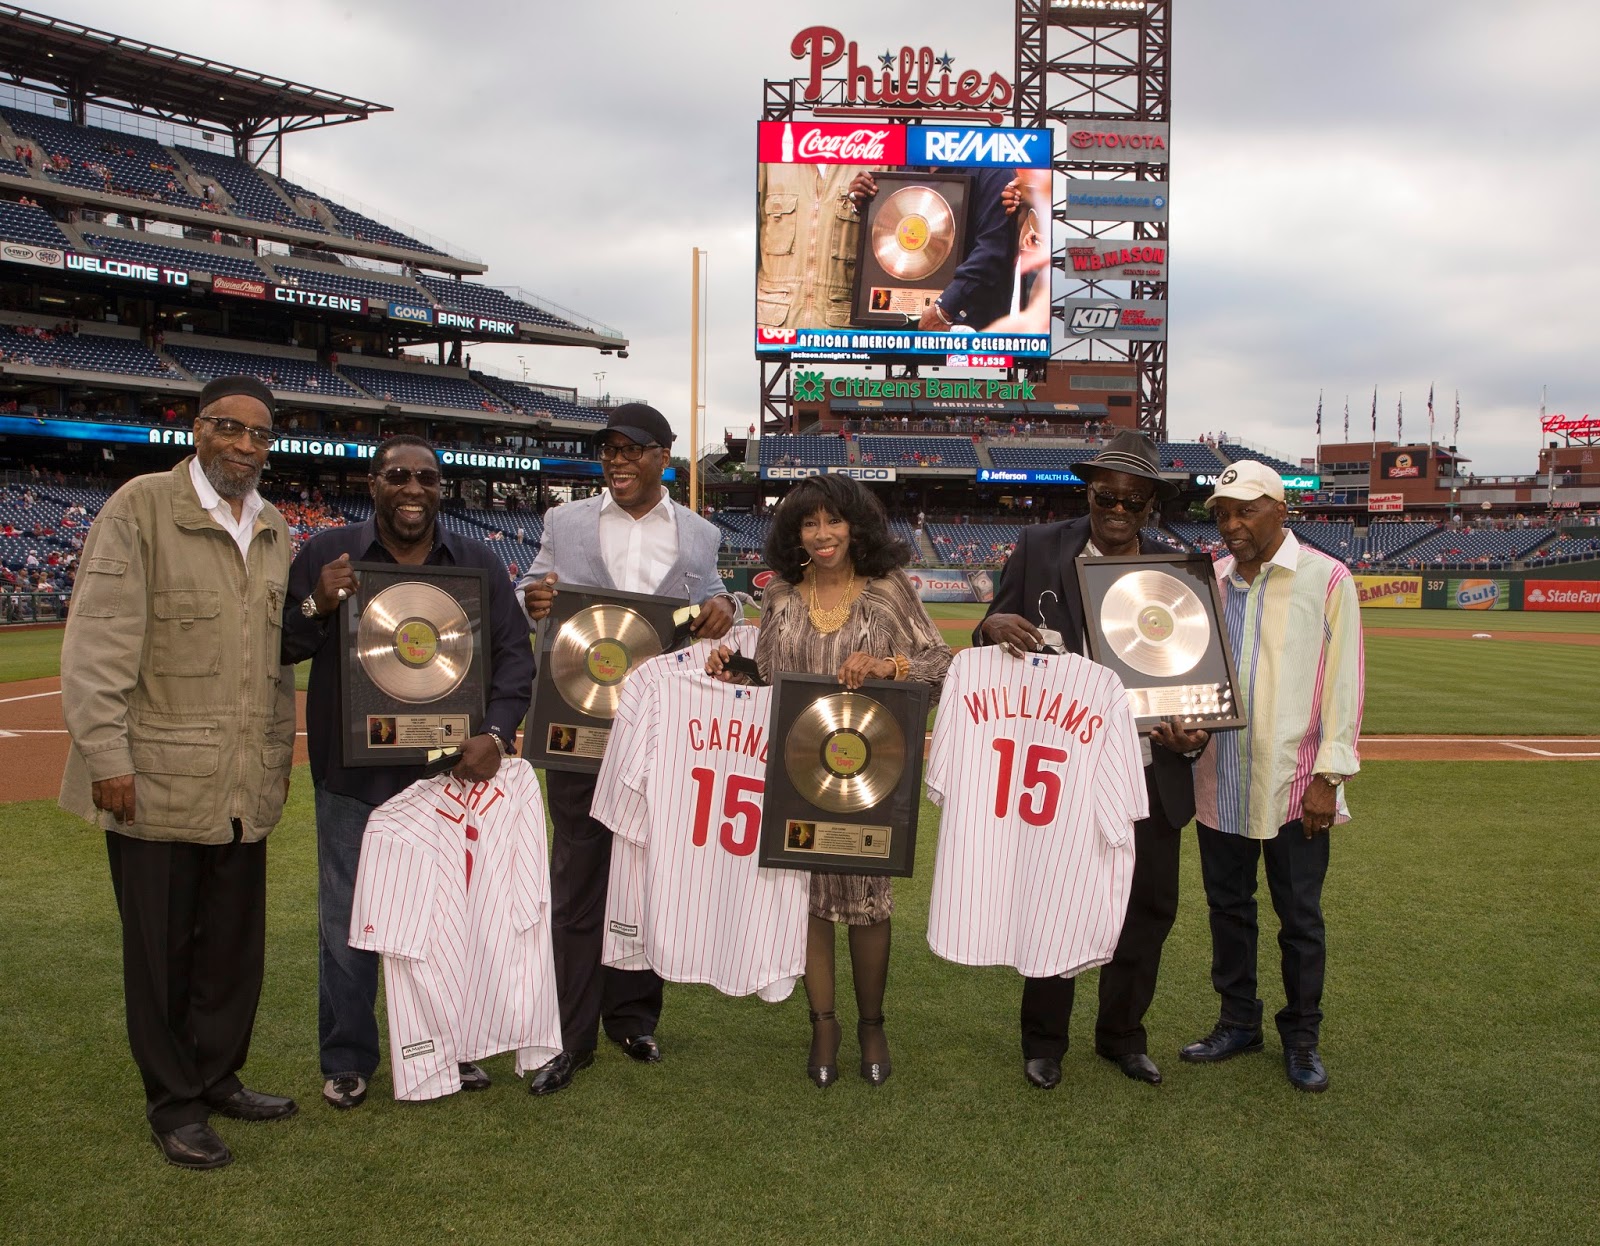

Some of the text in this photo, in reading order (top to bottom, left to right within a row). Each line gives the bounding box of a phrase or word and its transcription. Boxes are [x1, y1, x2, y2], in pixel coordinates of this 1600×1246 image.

[790, 25, 1014, 108] Phillies
[798, 128, 890, 160] Coca-Cola
[925, 130, 1033, 163] RE/MAX
[1094, 132, 1165, 150] TOYOTA
[67, 254, 188, 286] WELCOME TO
[274, 287, 361, 312] CITIZENS
[394, 306, 427, 320] GOYA
[438, 312, 515, 335] BANK PARK
[799, 334, 849, 349] AFRICAN
[852, 335, 910, 350] AMERICAN
[914, 336, 968, 351] HERITAGE
[971, 337, 1047, 352] CELEBRATION
[830, 377, 1036, 400] Citizens Bank Park
[933, 401, 970, 409] HARRY
[442, 451, 541, 471] CELEBRATION
[767, 467, 820, 479] GEICO
[990, 471, 1028, 481] Jefferson
[1035, 473, 1062, 481] HEALTH
[1427, 581, 1445, 591] 387
[1459, 586, 1497, 604] Gulf
[963, 685, 1104, 744] WILLIAMS
[991, 737, 1069, 827] 15
[691, 767, 765, 857] 15
